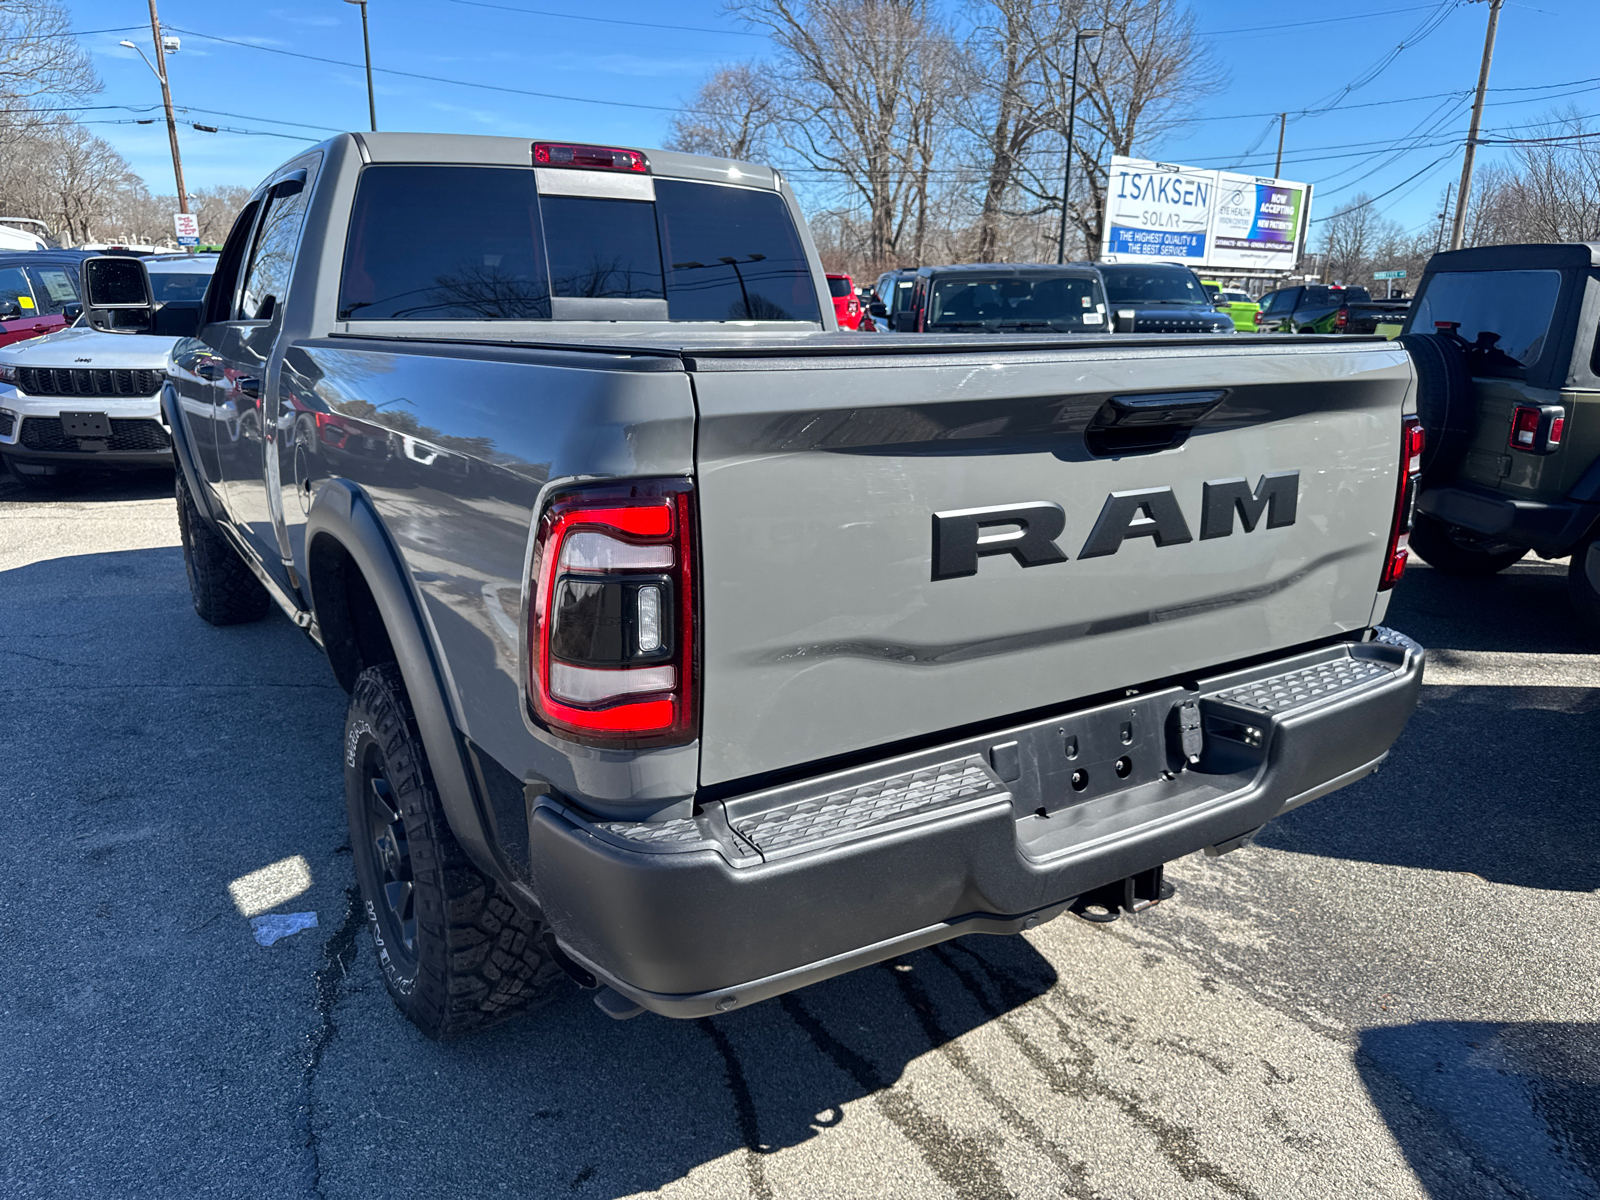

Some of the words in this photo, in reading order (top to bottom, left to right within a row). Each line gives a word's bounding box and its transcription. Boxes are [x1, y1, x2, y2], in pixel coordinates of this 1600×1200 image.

[1117, 171, 1209, 208] ISAKSEN
[1271, 193, 1287, 204] NOW
[1219, 206, 1229, 216] EYE
[1230, 207, 1251, 217] HEALTH
[1260, 203, 1294, 215] ACCEPTING
[1141, 210, 1180, 229] SOLAR
[1257, 219, 1269, 229] NEW
[1119, 230, 1133, 242] THE
[1133, 232, 1163, 244] HIGHEST
[1163, 234, 1191, 246] QUALITY
[1191, 236, 1197, 247] &
[1128, 243, 1142, 254] THE
[1142, 244, 1160, 255] BEST
[1160, 245, 1188, 257] SERVICE
[931, 470, 1300, 582] RAM
